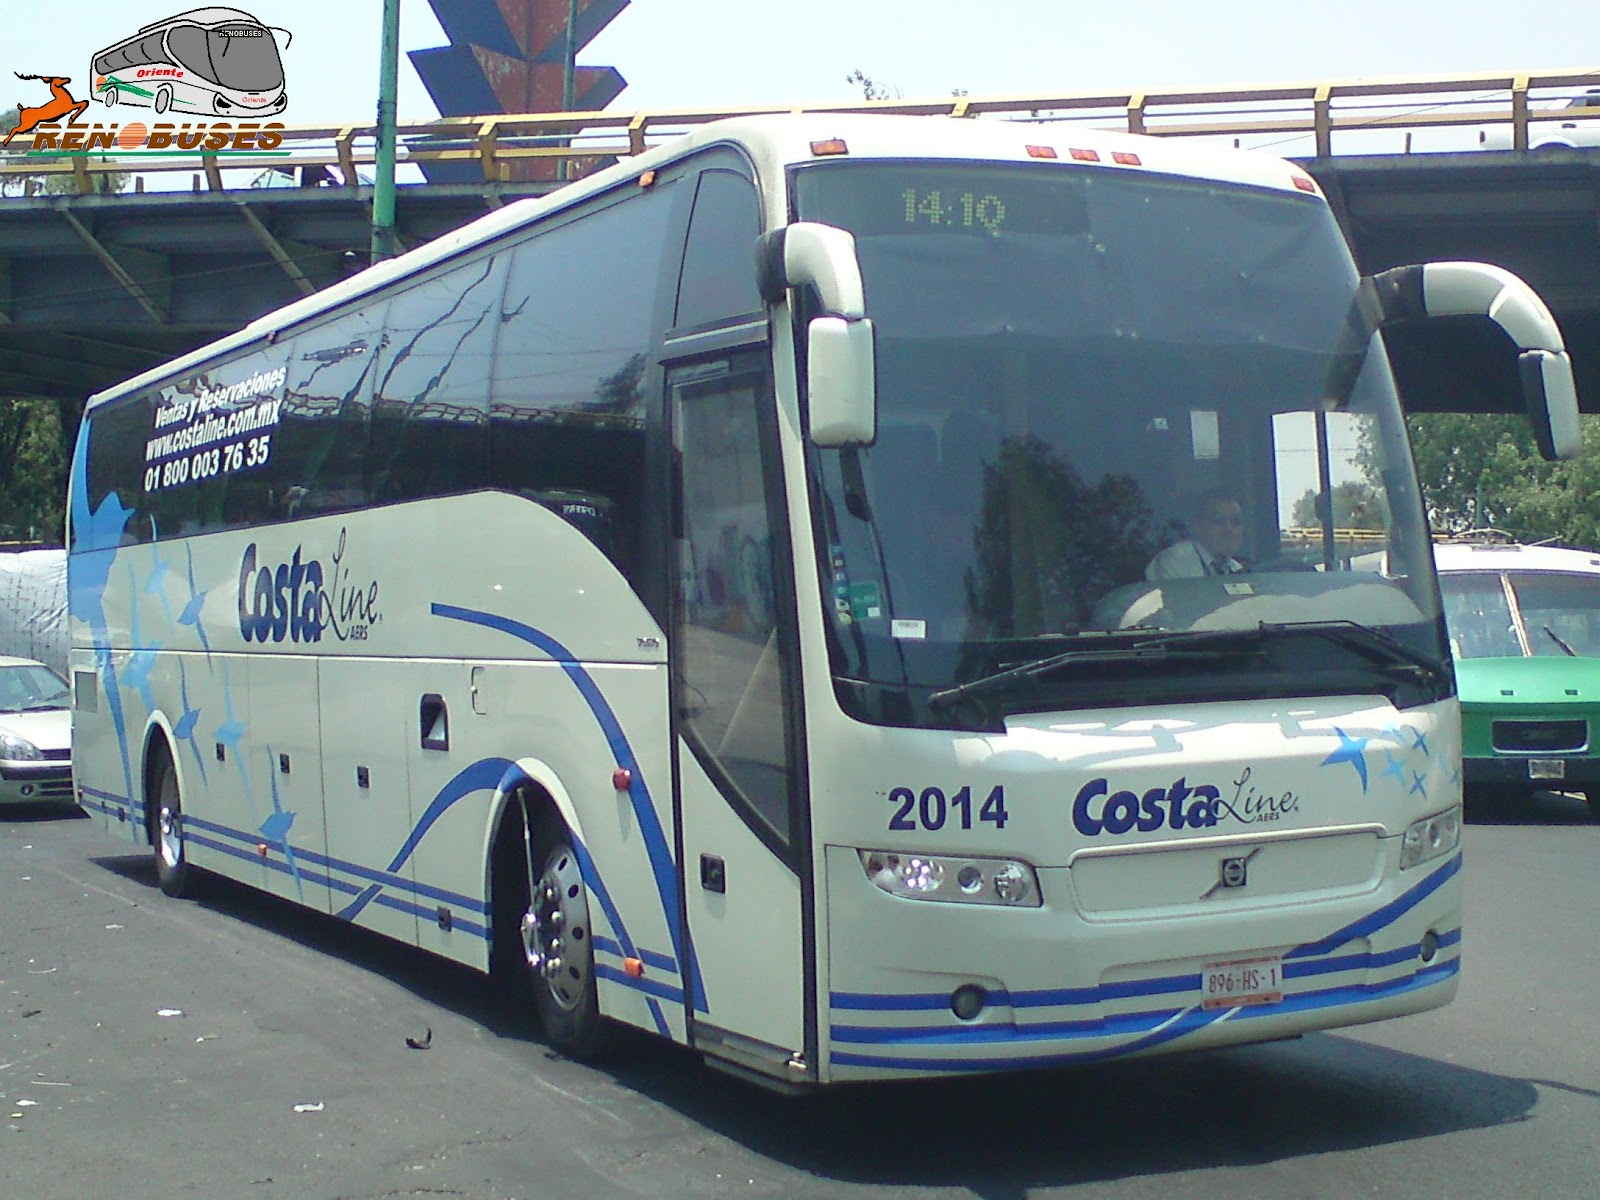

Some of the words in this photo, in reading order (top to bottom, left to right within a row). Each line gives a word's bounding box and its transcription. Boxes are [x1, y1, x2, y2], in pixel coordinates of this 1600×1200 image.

[901, 188, 1006, 230] 14:10
[154, 402, 188, 429] Ventas
[188, 397, 199, 423] y
[197, 366, 287, 414] Reservaciones
[145, 399, 283, 462] www.costaline.com.mx
[144, 465, 160, 493] 01
[162, 457, 190, 488] 800
[191, 448, 220, 481] 003
[223, 441, 245, 473] 76
[246, 435, 271, 467] 35
[238, 542, 324, 644] Costa
[350, 625, 369, 641] AERS
[887, 785, 1009, 831] 2014
[1072, 776, 1221, 837] Costa
[1256, 811, 1281, 823] AERS
